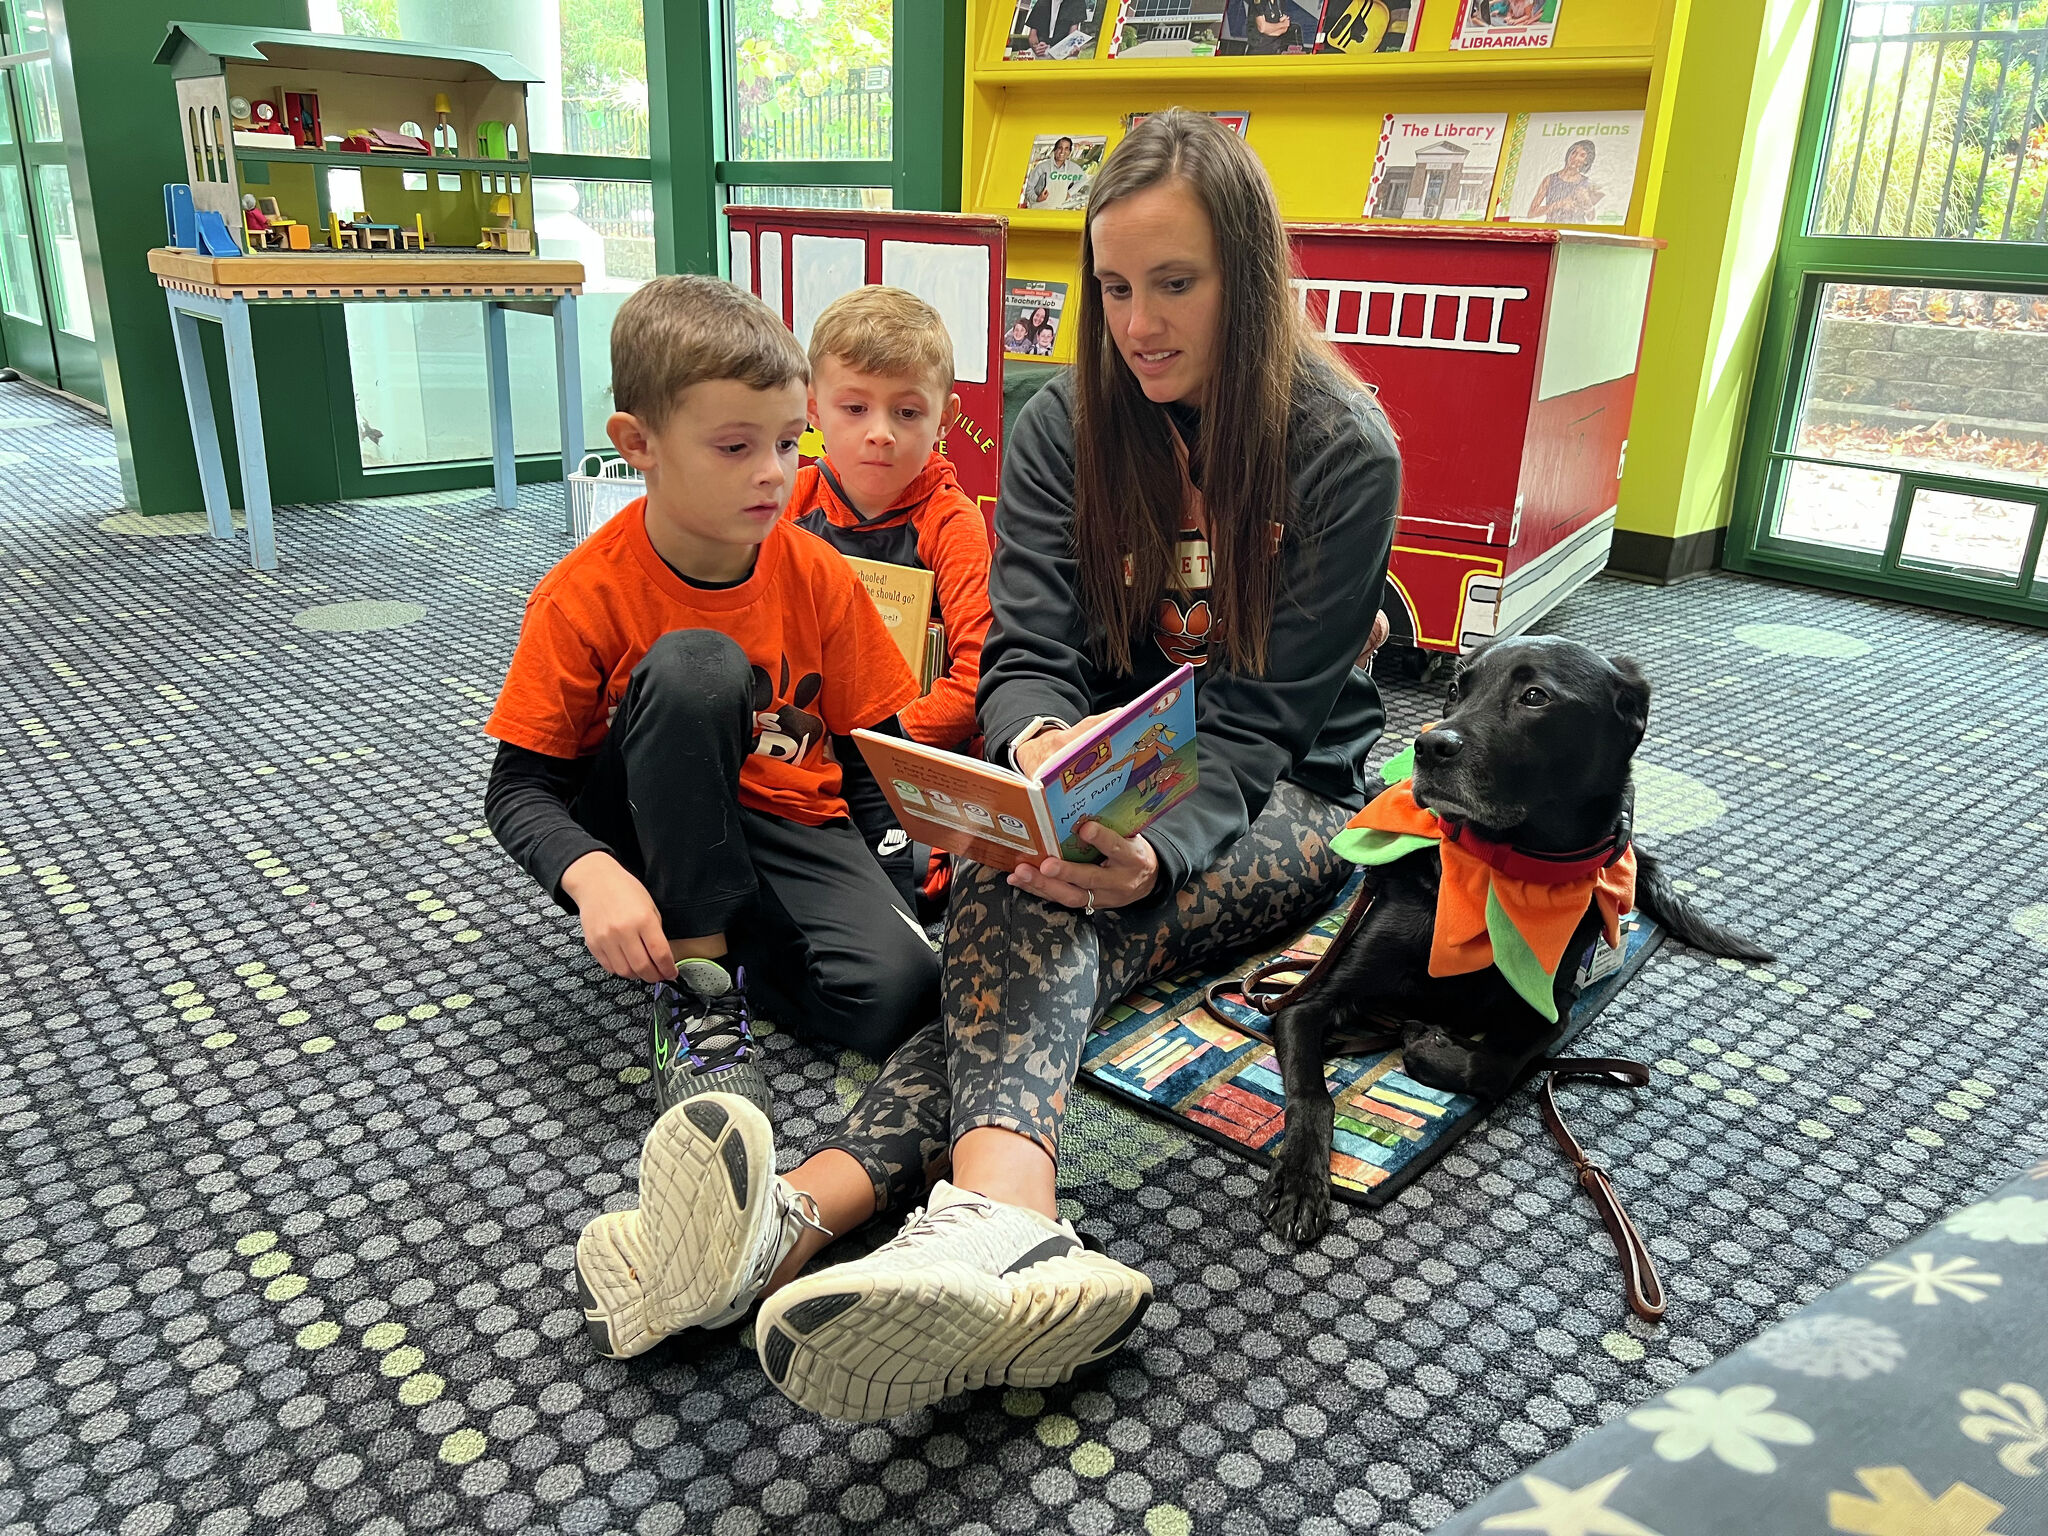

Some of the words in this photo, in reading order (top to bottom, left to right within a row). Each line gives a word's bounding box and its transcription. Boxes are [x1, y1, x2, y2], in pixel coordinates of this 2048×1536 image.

[1461, 35, 1548, 49] LIBRARIANS
[1402, 123, 1429, 137] The
[1434, 123, 1495, 140] Library
[1542, 122, 1630, 137] Librarians
[1050, 171, 1083, 182] Grocer
[856, 570, 888, 586] hooled!
[876, 587, 901, 602] should
[902, 593, 916, 606] go?
[1063, 741, 1109, 786] BOB
[1060, 801, 1087, 824] New
[1090, 773, 1123, 800] Puppy
